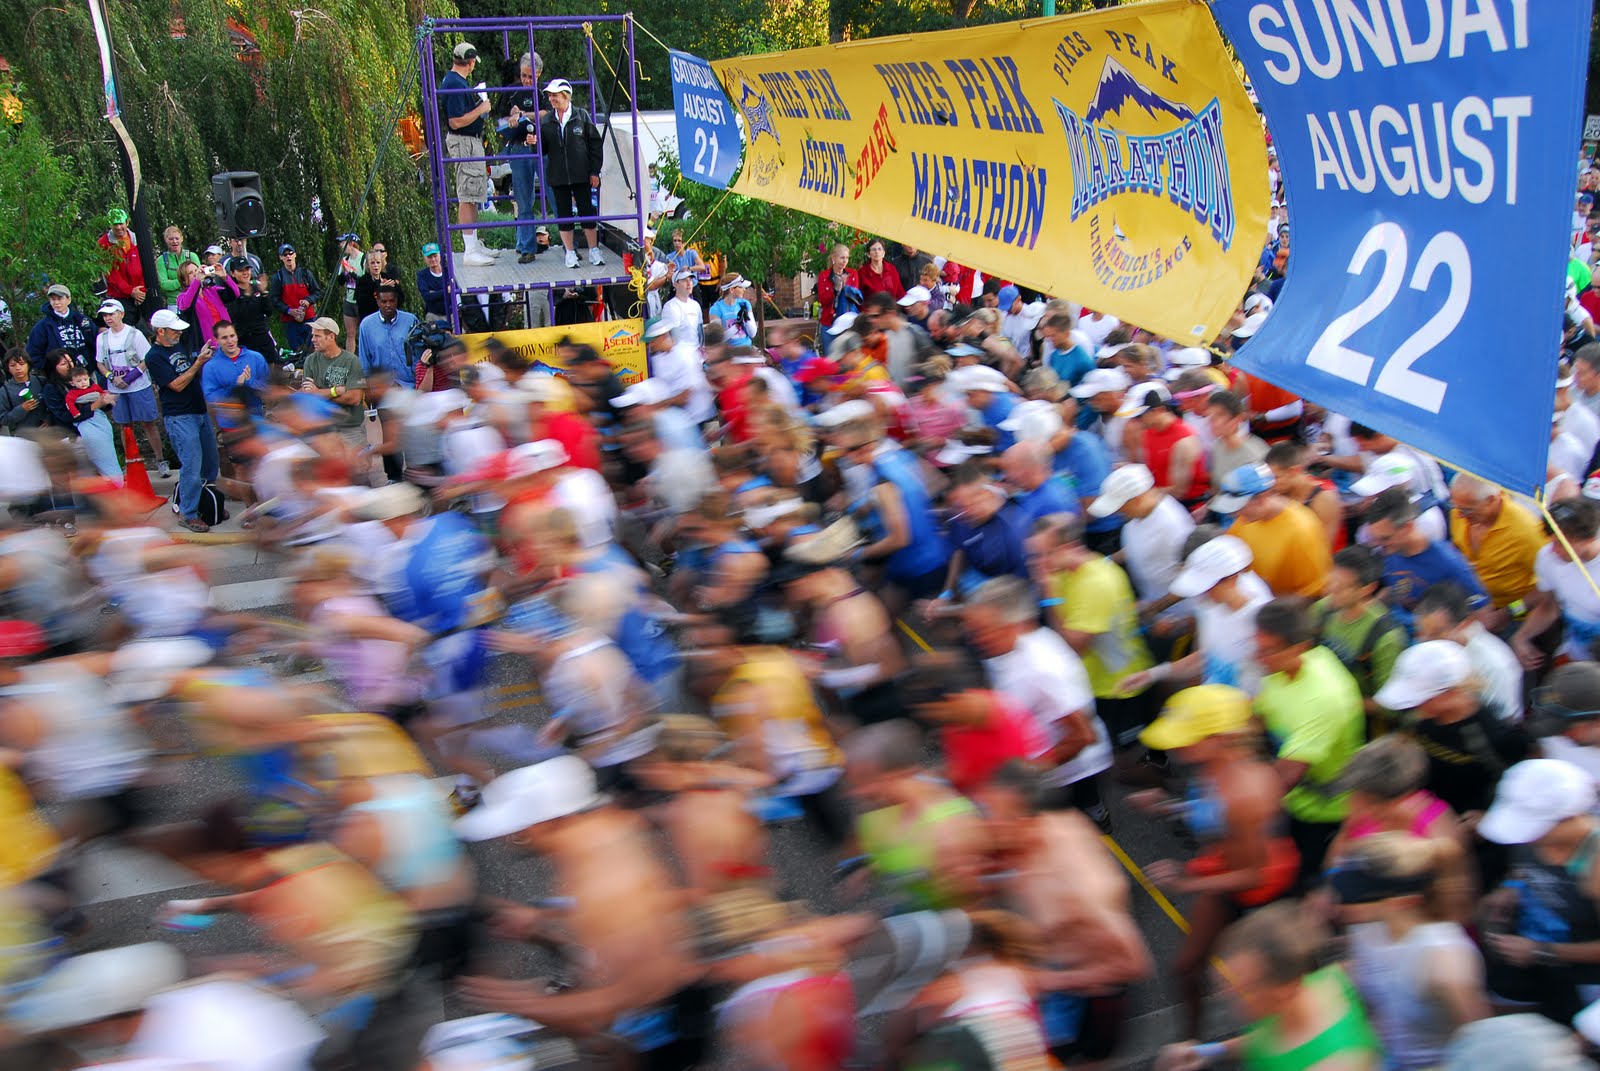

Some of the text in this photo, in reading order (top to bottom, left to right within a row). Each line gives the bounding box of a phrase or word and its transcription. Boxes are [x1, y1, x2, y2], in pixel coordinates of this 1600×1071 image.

[1053, 29, 1178, 86] PIKES PEAK
[1248, 0, 1529, 85] SUNDAY
[673, 56, 719, 91] SATURDAY
[758, 72, 809, 119] PIKES
[794, 69, 851, 121] PEAK
[874, 56, 1044, 134] PIKES PEAK
[683, 93, 726, 125] AUGUST
[694, 127, 719, 177] 21
[799, 139, 847, 198] ASCENT
[854, 102, 897, 200] START
[1051, 97, 1235, 252] MARATHON
[1306, 96, 1532, 205] AUGUST
[911, 152, 1047, 250] MARATHON
[1090, 214, 1192, 292] ULTIMATE CHALLENGE
[1105, 236, 1162, 272] AMERICA'S
[603, 333, 640, 352] ASCENT
[1306, 222, 1472, 414] 22
[511, 343, 545, 358] ROWN
